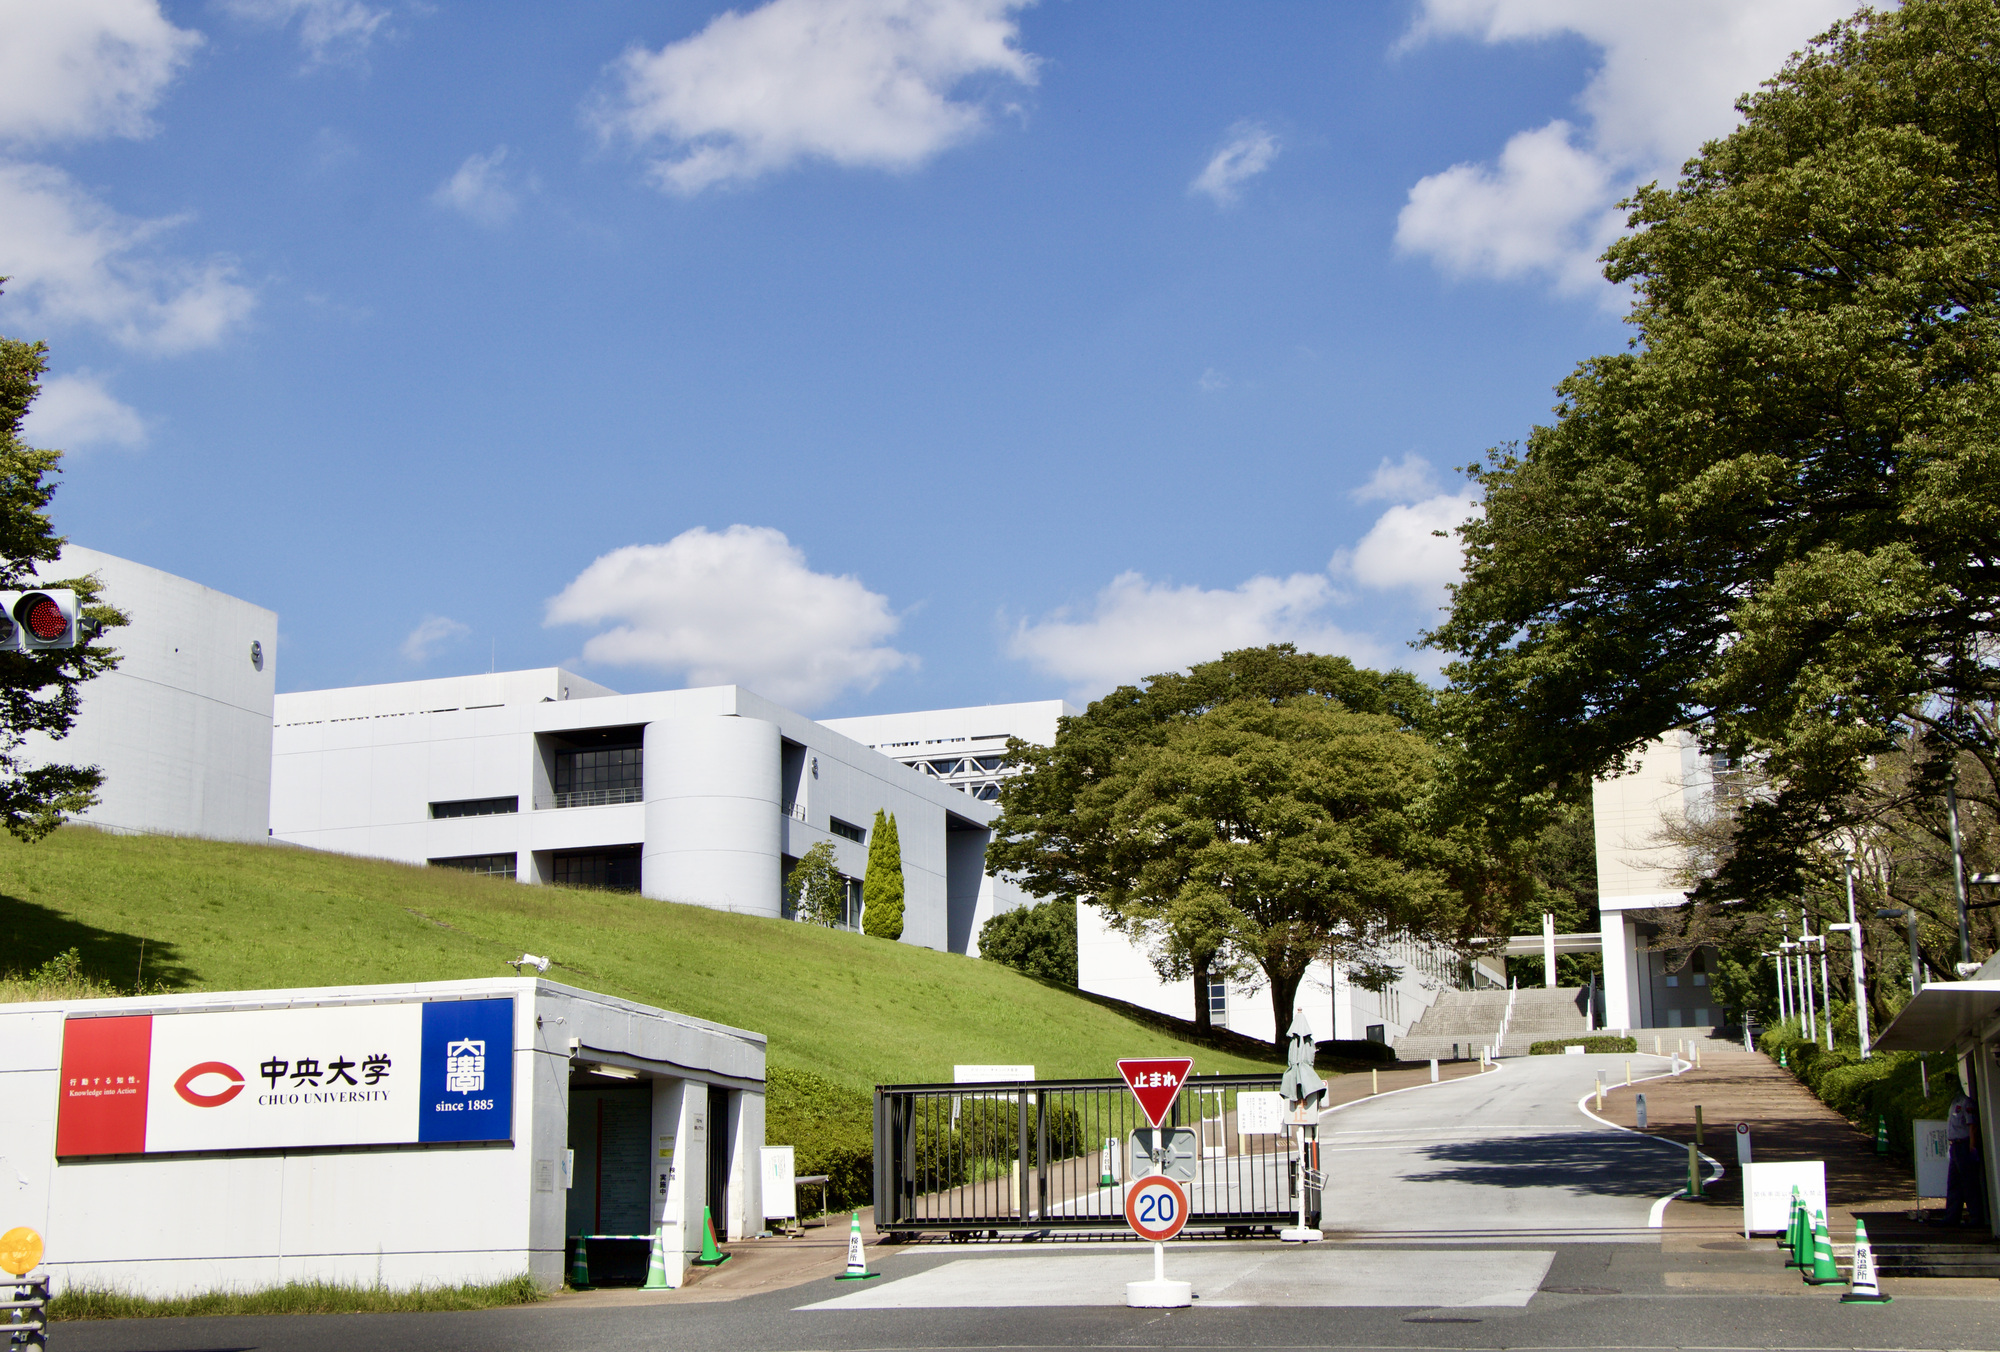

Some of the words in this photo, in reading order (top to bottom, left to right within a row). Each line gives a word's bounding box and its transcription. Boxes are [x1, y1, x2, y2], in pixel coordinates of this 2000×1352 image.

[260, 1053, 392, 1090] 中央大学
[1133, 1071, 1178, 1089] 止まれ
[69, 1089, 103, 1097] Knowledge
[103, 1088, 116, 1096] into
[116, 1087, 137, 1095] Action
[258, 1093, 299, 1106] CHUO
[304, 1090, 391, 1104] UNIVERSITY
[435, 1100, 464, 1112] since
[467, 1099, 494, 1111] 1885
[1139, 1193, 1174, 1222] 20
[849, 1236, 859, 1262] 検温所
[1856, 1248, 1867, 1280] 検温所
